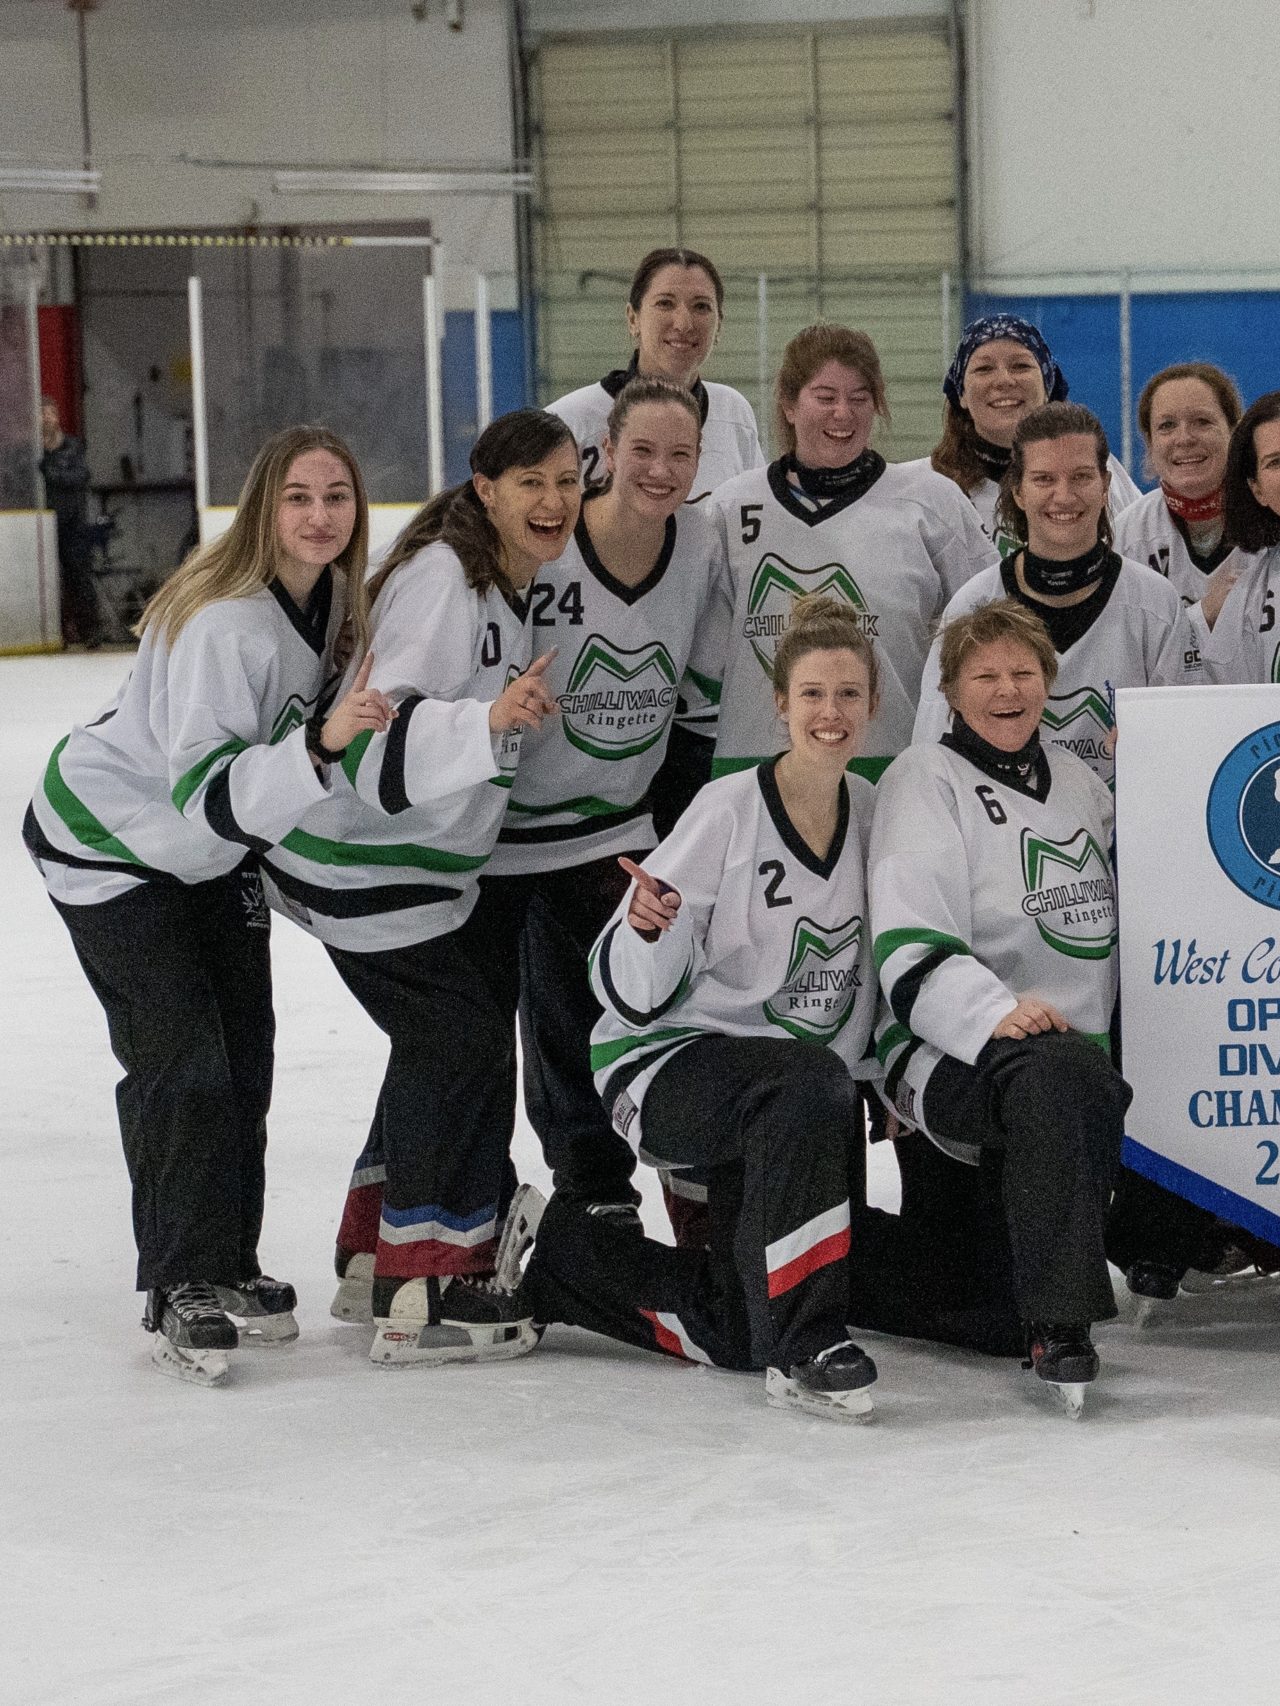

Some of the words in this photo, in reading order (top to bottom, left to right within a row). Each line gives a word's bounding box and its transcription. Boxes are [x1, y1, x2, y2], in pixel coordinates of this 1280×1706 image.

[741, 504, 763, 545] 5
[532, 581, 585, 626] 24
[586, 713, 656, 729] Ringette
[975, 784, 1008, 825] 6
[758, 860, 793, 908] 2
[1022, 878, 1115, 917] CHILLIWA
[1152, 937, 1231, 985] West
